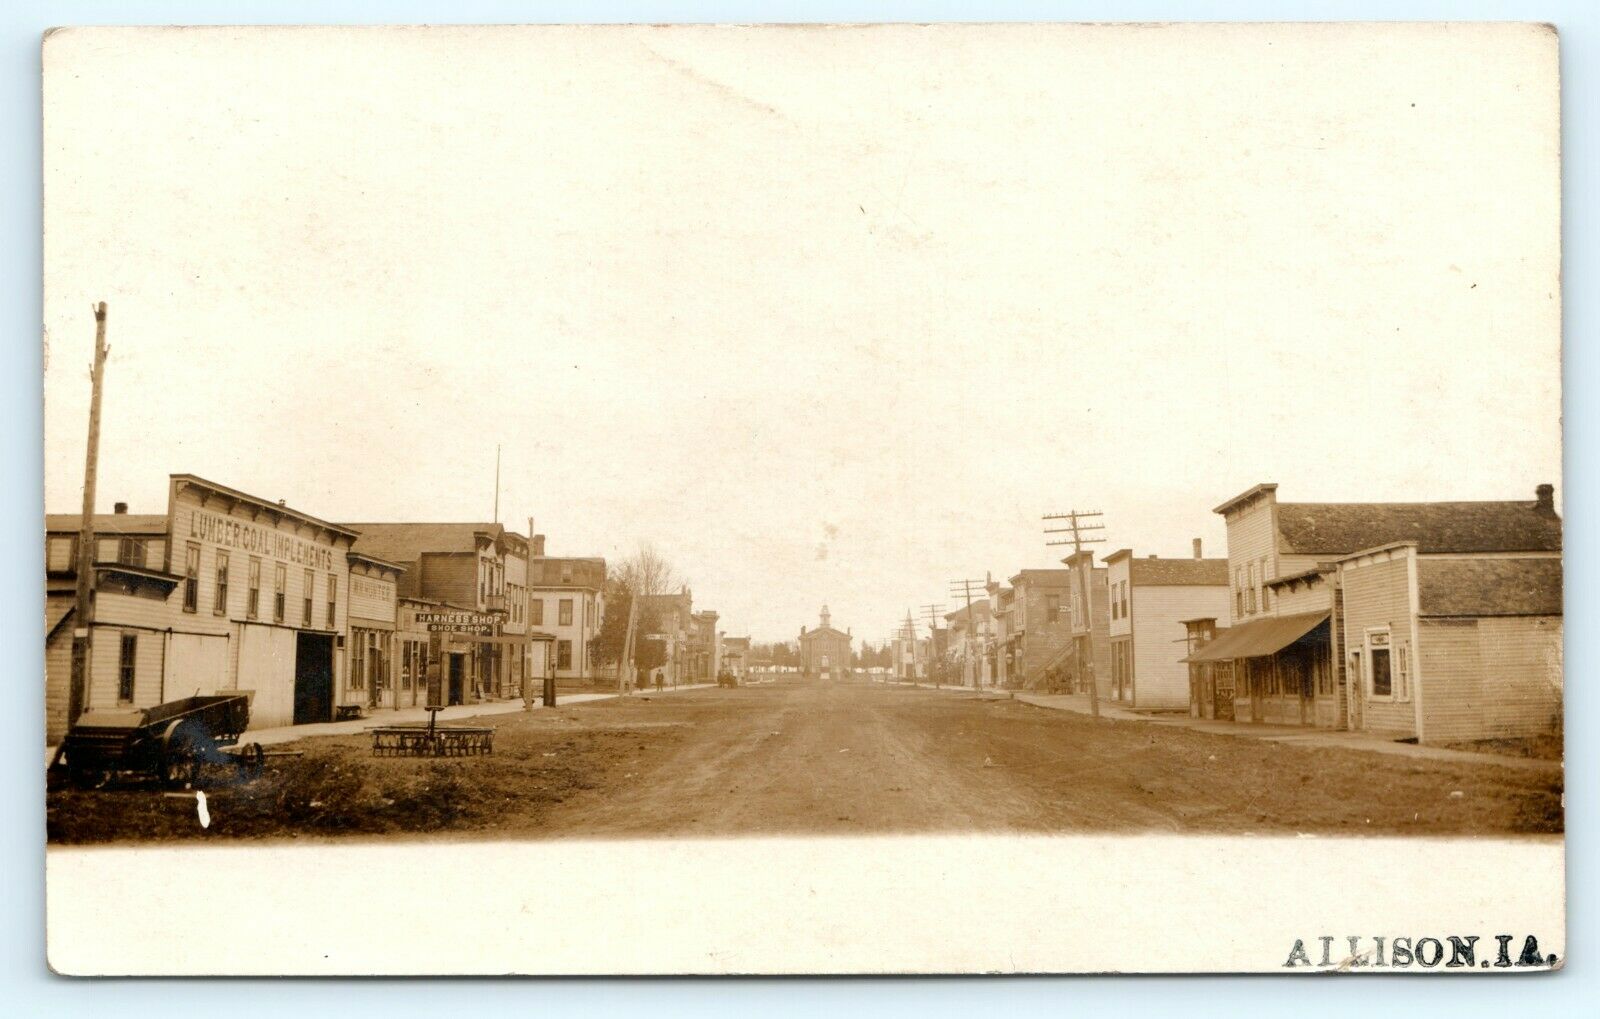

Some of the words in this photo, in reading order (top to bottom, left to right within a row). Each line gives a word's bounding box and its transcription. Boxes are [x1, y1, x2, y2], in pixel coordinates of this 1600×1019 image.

[190, 511, 240, 548] LUMBER
[242, 526, 270, 555] COAL
[273, 533, 332, 571] IMPLEMENTS
[419, 614, 469, 624] HARNESS
[472, 616, 505, 625] SHOP.
[460, 625, 491, 633] SHOP.
